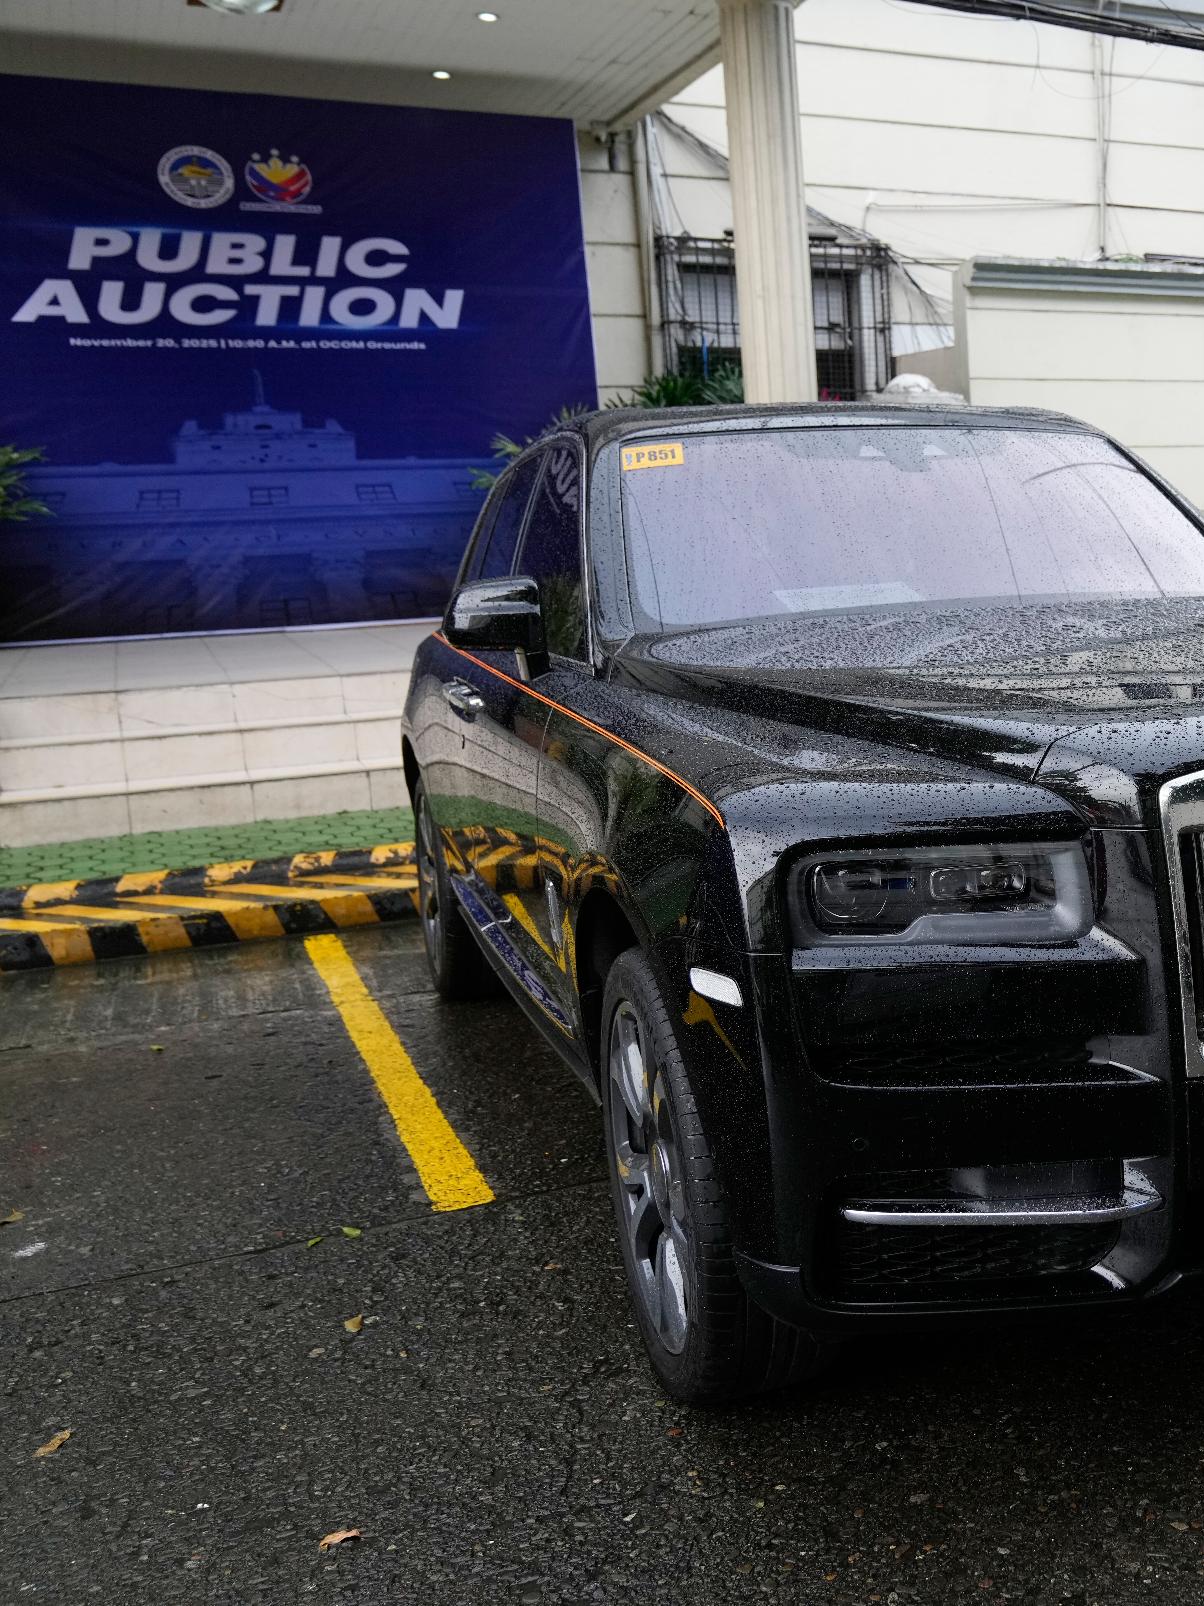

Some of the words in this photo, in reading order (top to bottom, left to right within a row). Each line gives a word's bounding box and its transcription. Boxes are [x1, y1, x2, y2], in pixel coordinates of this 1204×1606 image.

[67, 226, 411, 279] PUBLIC
[10, 278, 465, 330] AUCTION
[69, 337, 153, 348] November
[181, 338, 219, 348] 2025
[367, 340, 426, 350] Grounds
